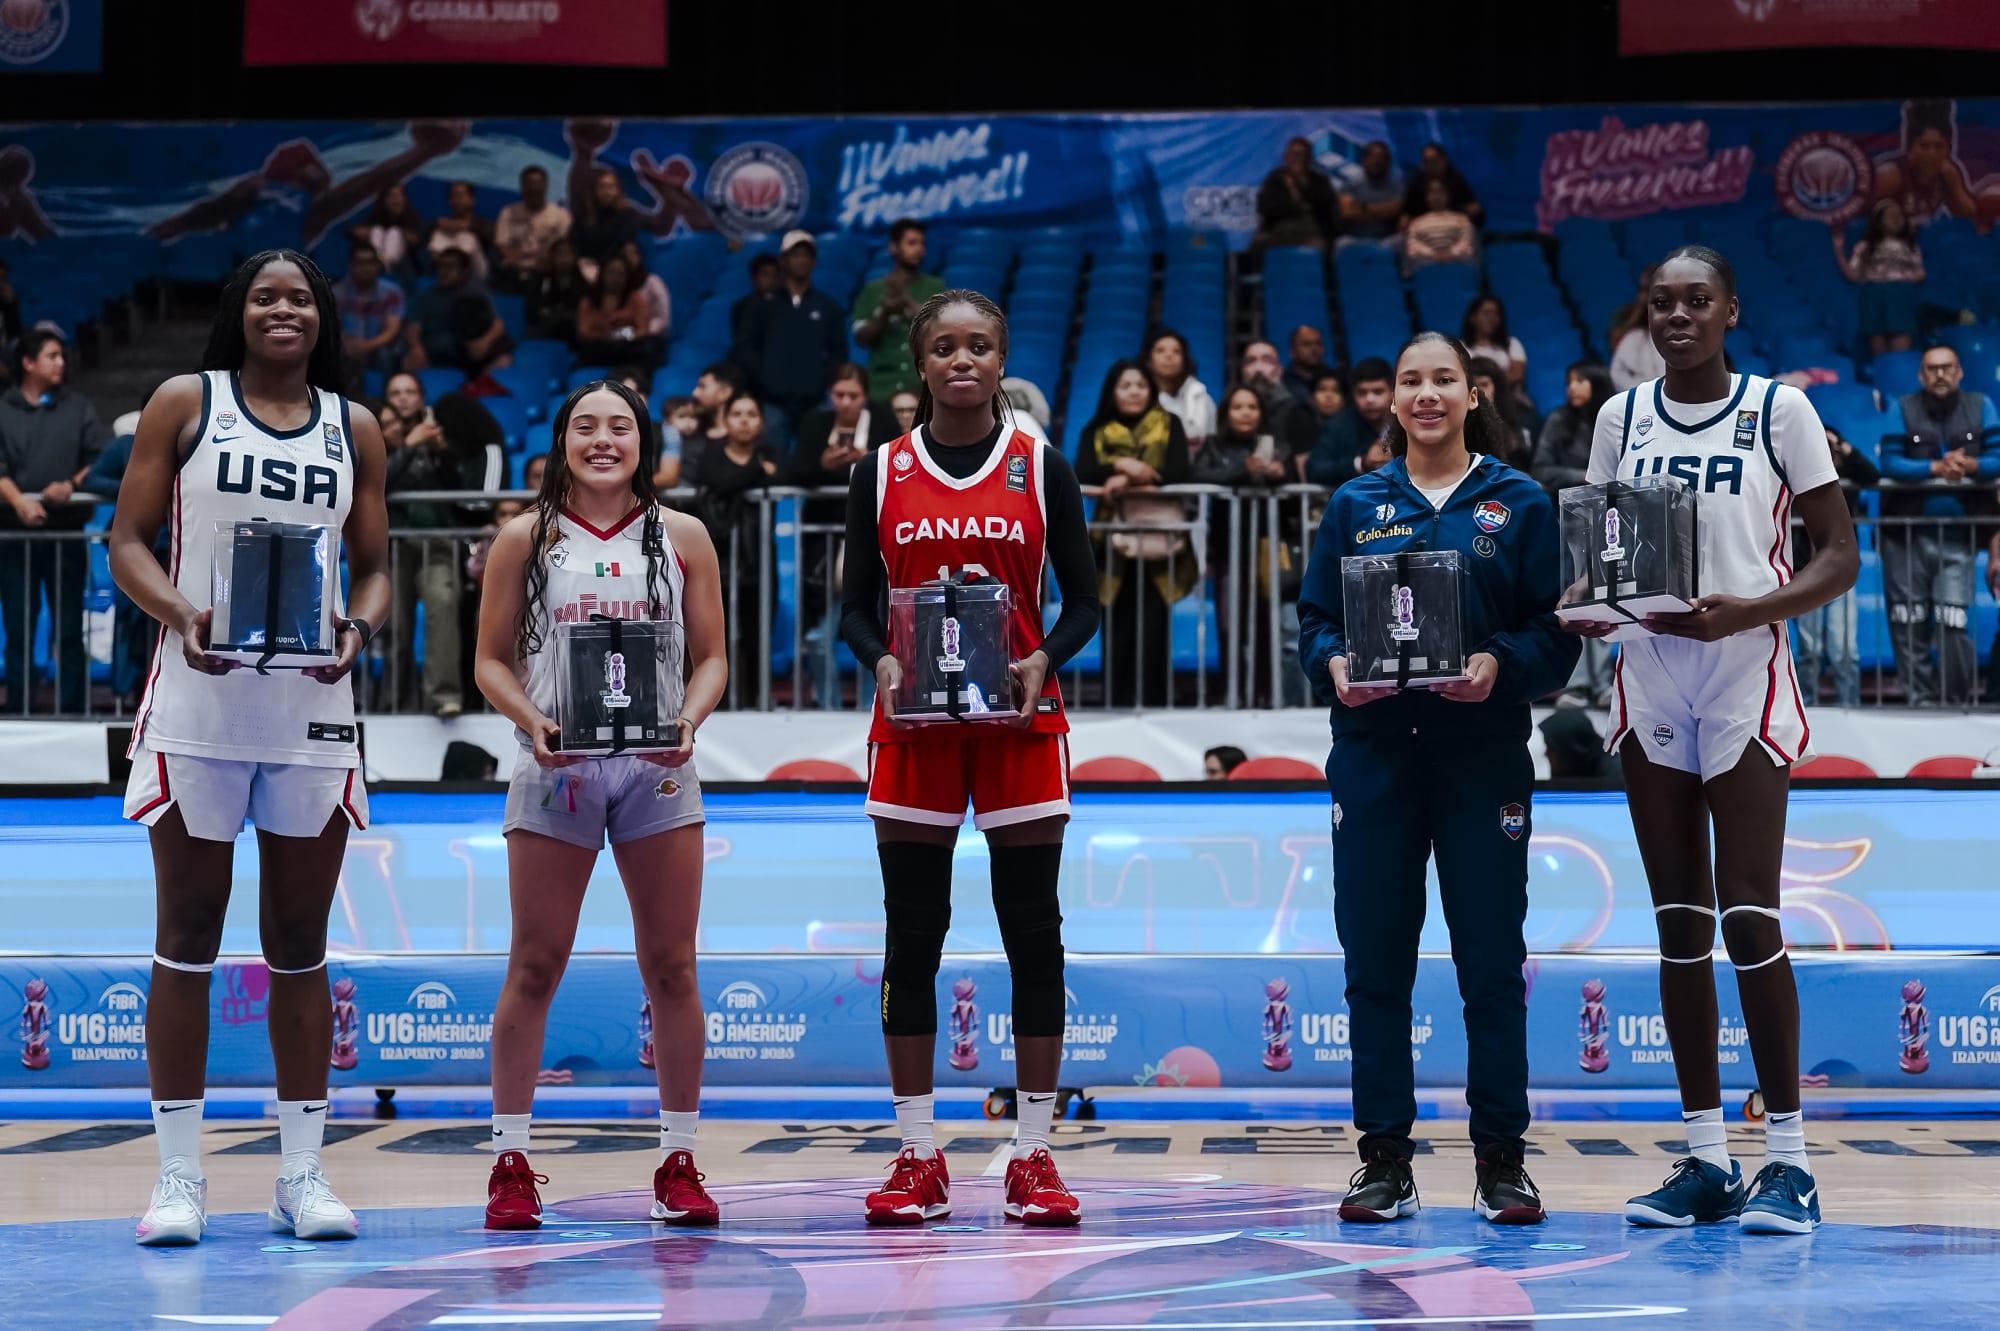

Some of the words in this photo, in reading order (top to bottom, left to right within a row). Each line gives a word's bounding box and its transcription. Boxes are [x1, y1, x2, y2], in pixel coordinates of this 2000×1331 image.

[1737, 431, 1752, 441] FIBA
[217, 451, 338, 509] USA
[1009, 475, 1024, 484] FIBA
[1633, 455, 1743, 495] USA
[1475, 509, 1506, 525] FCB
[895, 516, 1026, 545] CANADA
[1503, 815, 1524, 827] FCB
[108, 994, 139, 1010] FIBA
[416, 993, 447, 1010] FIBA
[726, 993, 757, 1009] FIBA
[726, 1013, 807, 1024] WOMEN'S
[58, 1013, 107, 1045] U16
[367, 1012, 416, 1045] U16
[416, 1023, 494, 1043] AMERICUP
[726, 1023, 807, 1043] AMERICUP
[1063, 1024, 1118, 1044] ERICUP
[1301, 1013, 1350, 1045] U16
[1617, 1014, 1669, 1047] U16
[1938, 1015, 1988, 1048] U16
[71, 1047, 139, 1061] IRAPUATO
[380, 1047, 448, 1060] IRAPUATO
[449, 1047, 485, 1060] 2025
[704, 1046, 758, 1060] APUATO
[760, 1046, 796, 1060] 2025
[1071, 1048, 1107, 1061] 2025
